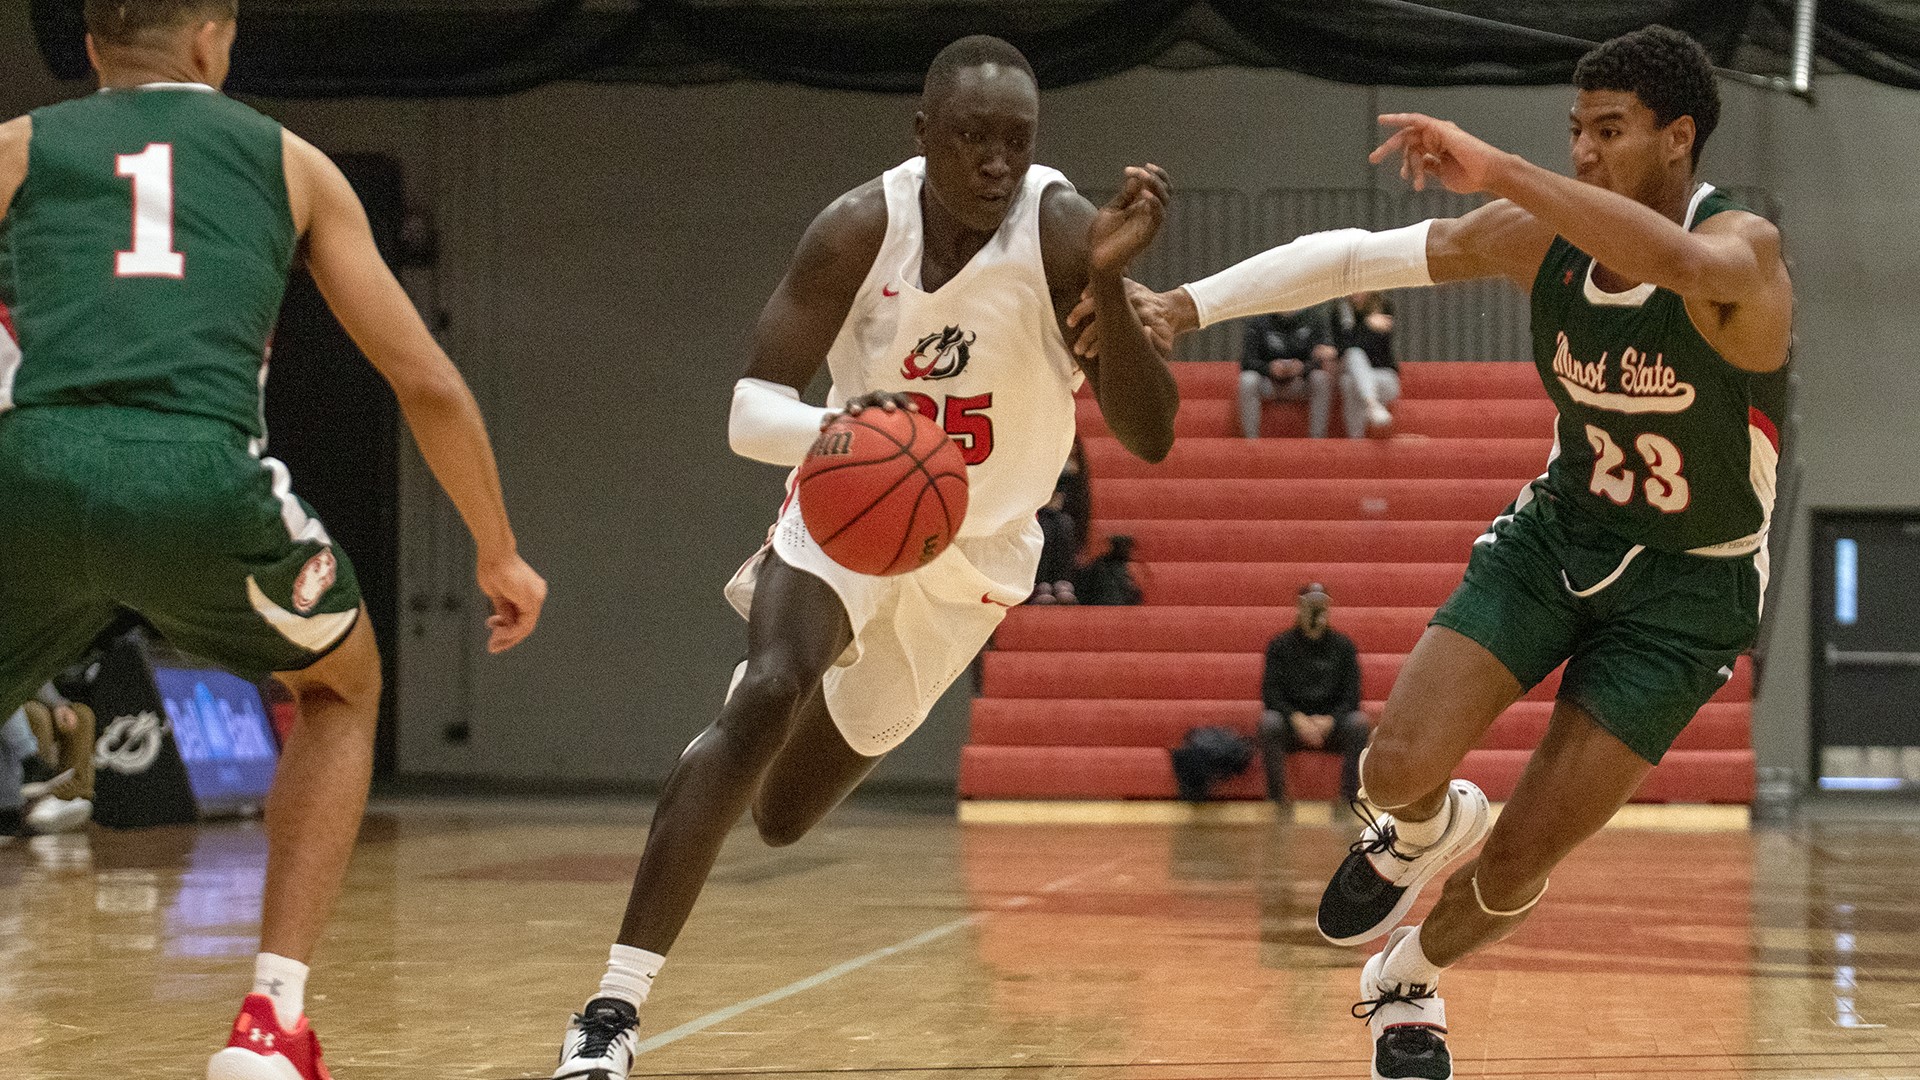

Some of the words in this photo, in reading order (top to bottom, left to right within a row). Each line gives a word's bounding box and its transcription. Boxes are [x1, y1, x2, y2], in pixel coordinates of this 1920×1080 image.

[114, 142, 186, 279] 1
[1552, 330, 1608, 392] Minot
[1620, 345, 1680, 394] State
[1584, 423, 1690, 514] 23
